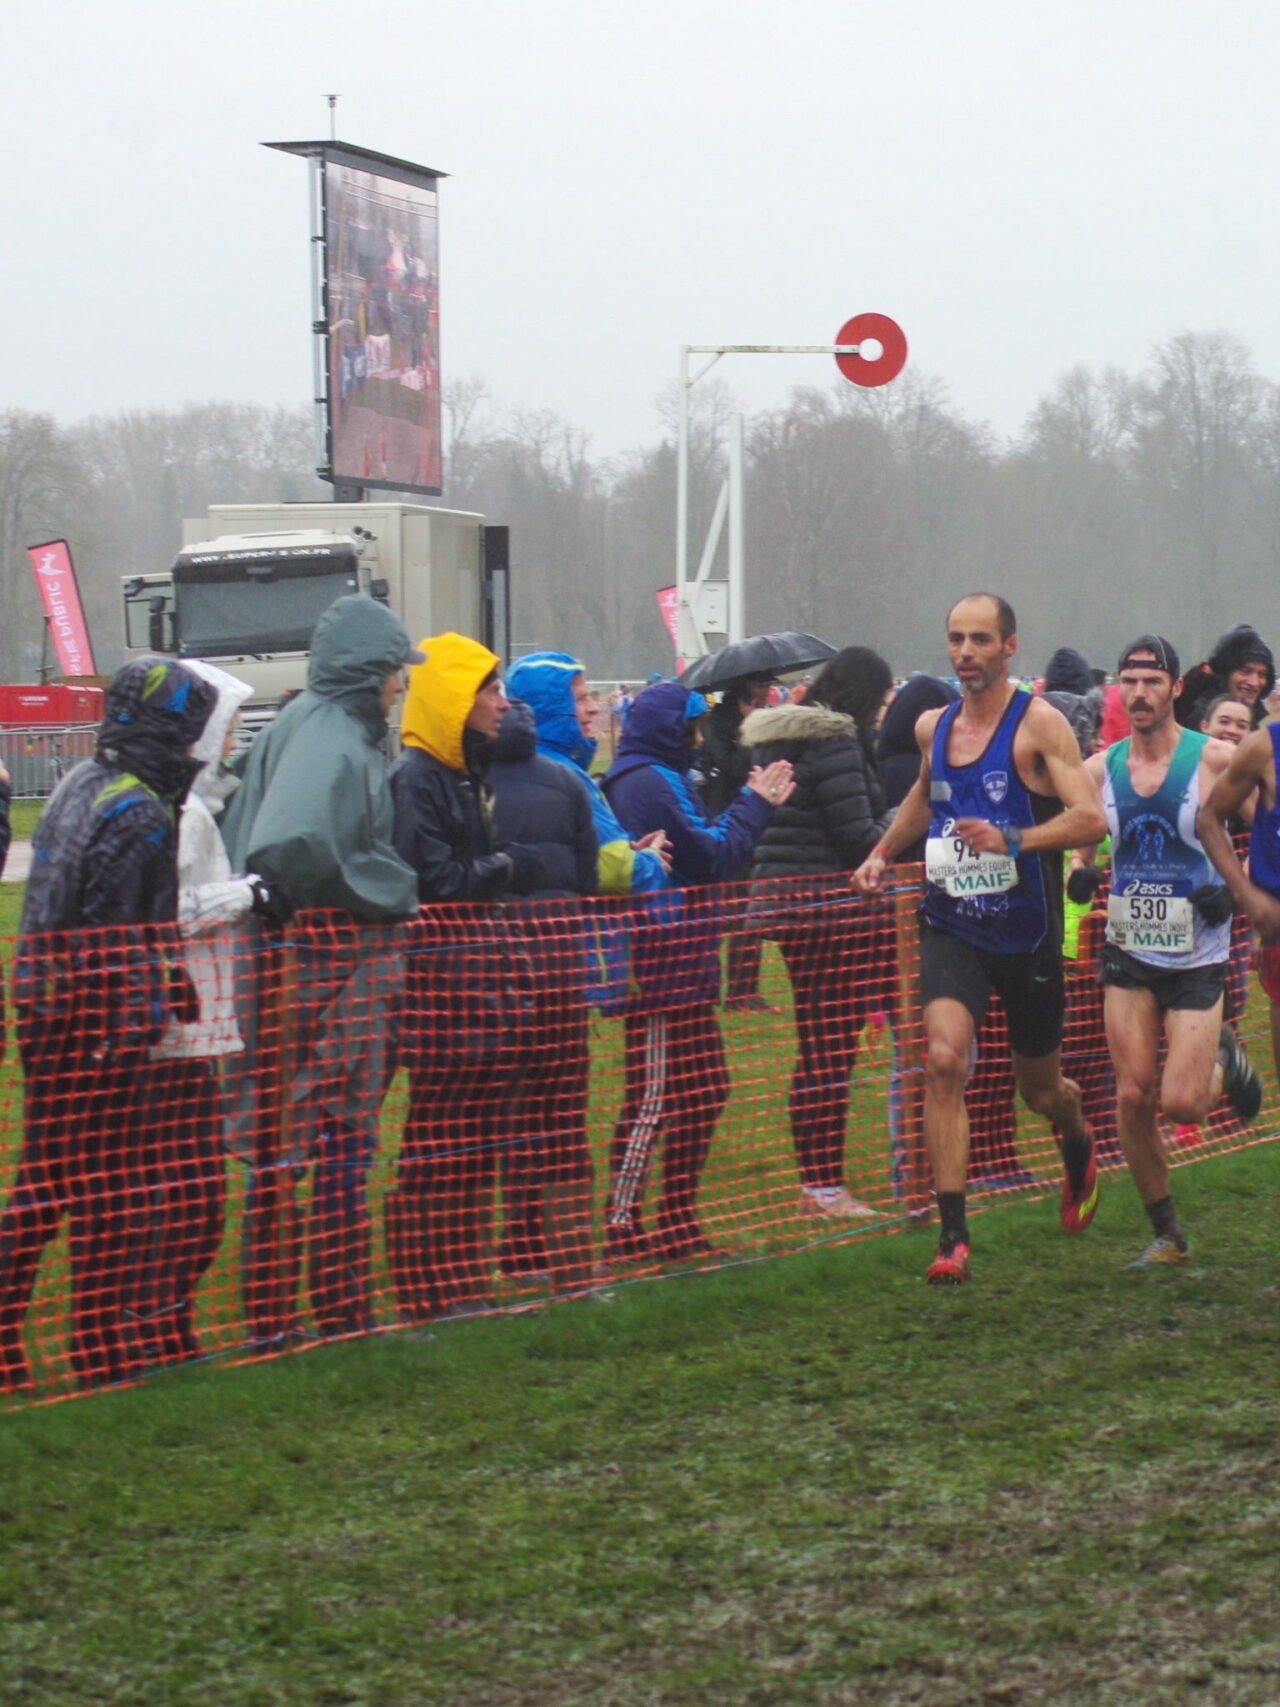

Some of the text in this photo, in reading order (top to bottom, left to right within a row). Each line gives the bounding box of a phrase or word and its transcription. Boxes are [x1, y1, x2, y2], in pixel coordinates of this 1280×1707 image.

[954, 872, 1011, 891] MAIF
[1139, 883, 1174, 896] asics
[1130, 898, 1167, 920] 530
[1133, 932, 1187, 947] MAIF
